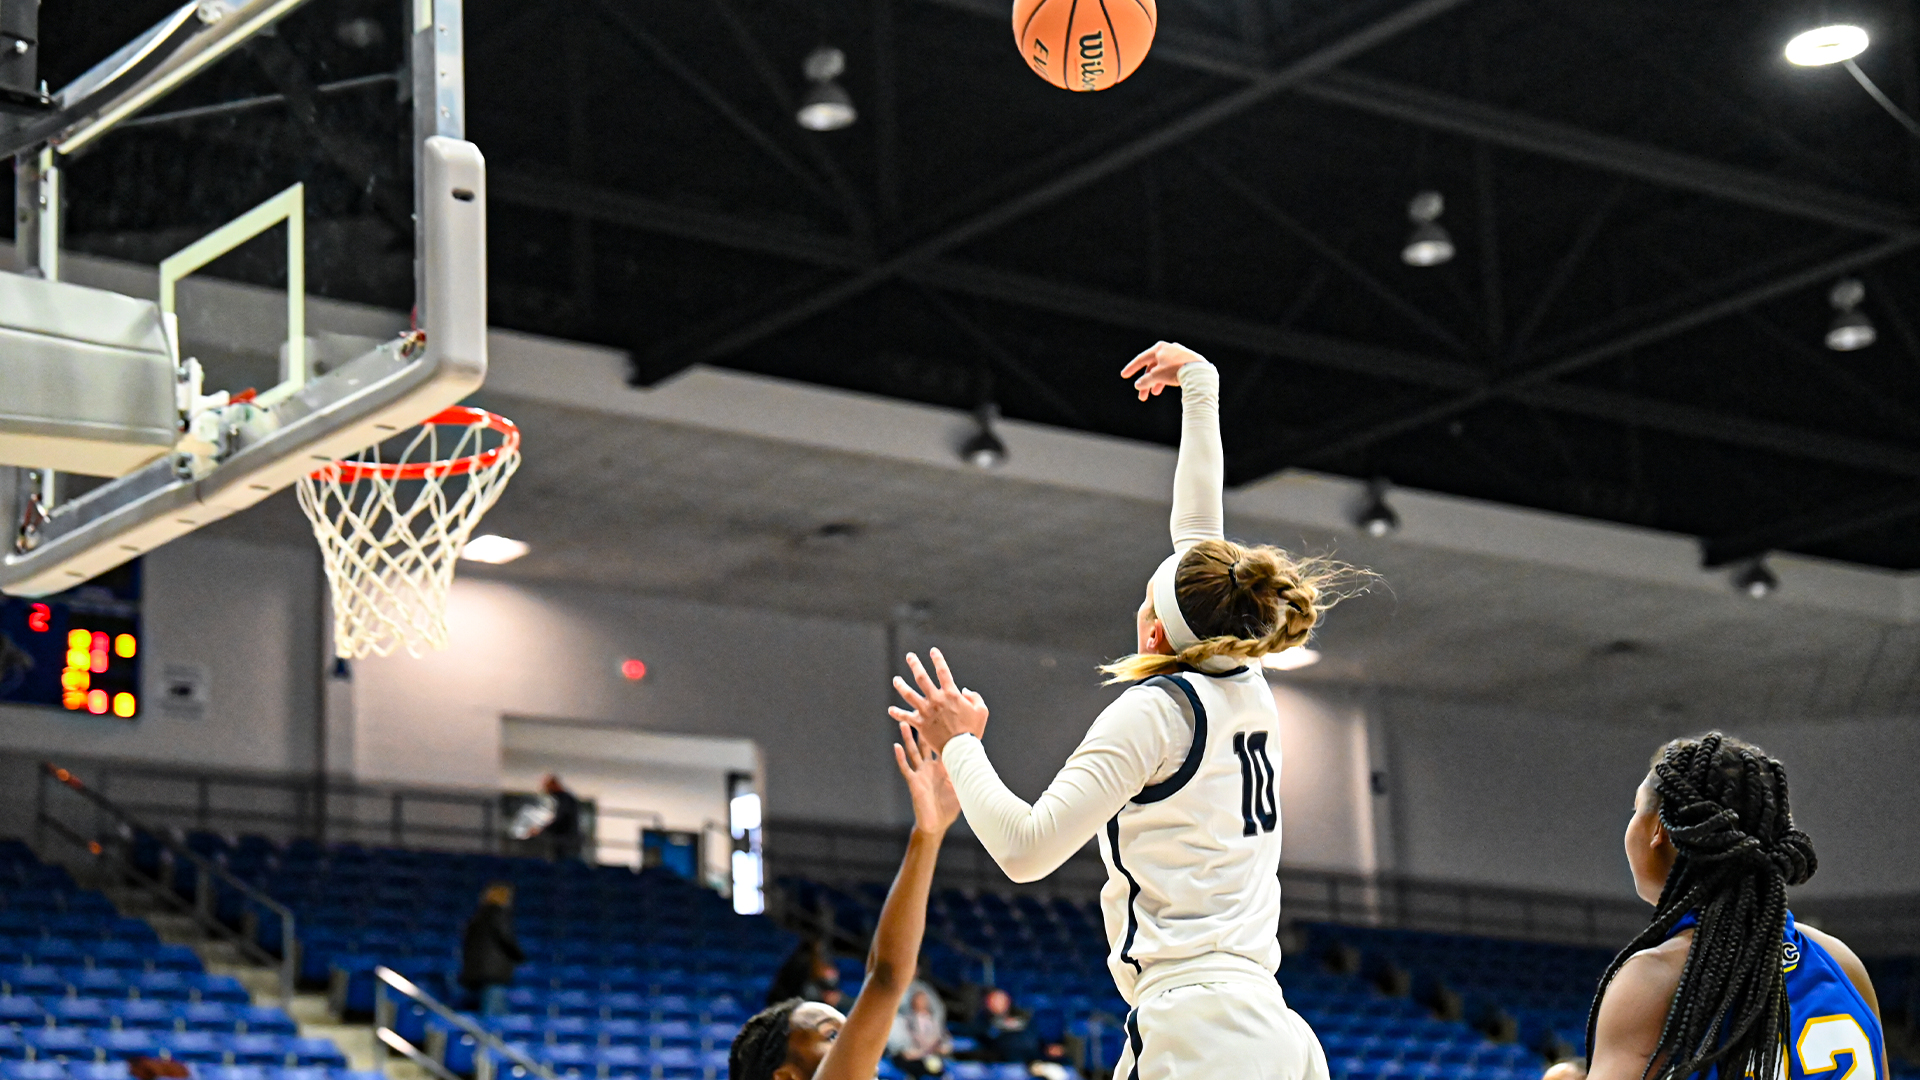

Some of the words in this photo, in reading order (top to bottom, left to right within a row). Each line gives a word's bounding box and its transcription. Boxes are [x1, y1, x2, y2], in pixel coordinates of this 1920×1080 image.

[29, 603, 50, 632] 2
[1233, 730, 1277, 837] 10
[1745, 1013, 1876, 1080] 2
